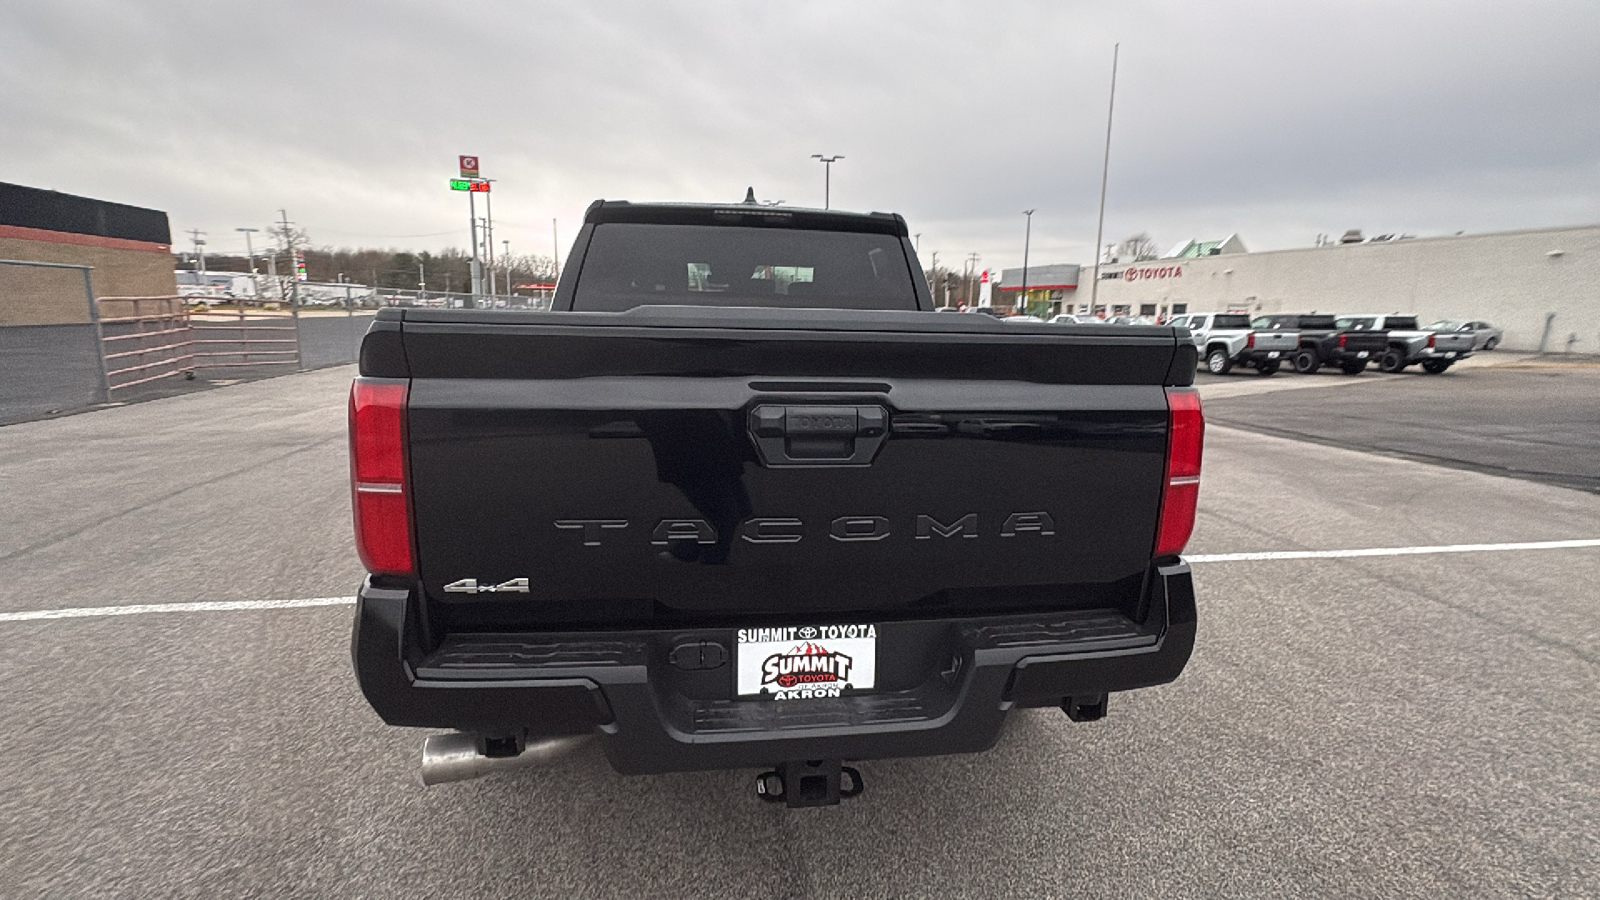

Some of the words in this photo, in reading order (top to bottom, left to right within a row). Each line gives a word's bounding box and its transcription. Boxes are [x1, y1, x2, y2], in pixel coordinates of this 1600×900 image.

[1137, 266, 1182, 279] TOYOTA
[789, 416, 854, 429] TOYOTA
[554, 511, 1055, 546] TACOMA
[443, 578, 530, 593] 4x4
[738, 627, 797, 642] SUMMIT
[819, 624, 876, 638] TOYOTA
[763, 653, 851, 684] SUMMIT
[798, 674, 836, 682] TOYOTA
[774, 688, 840, 700] AKRON
